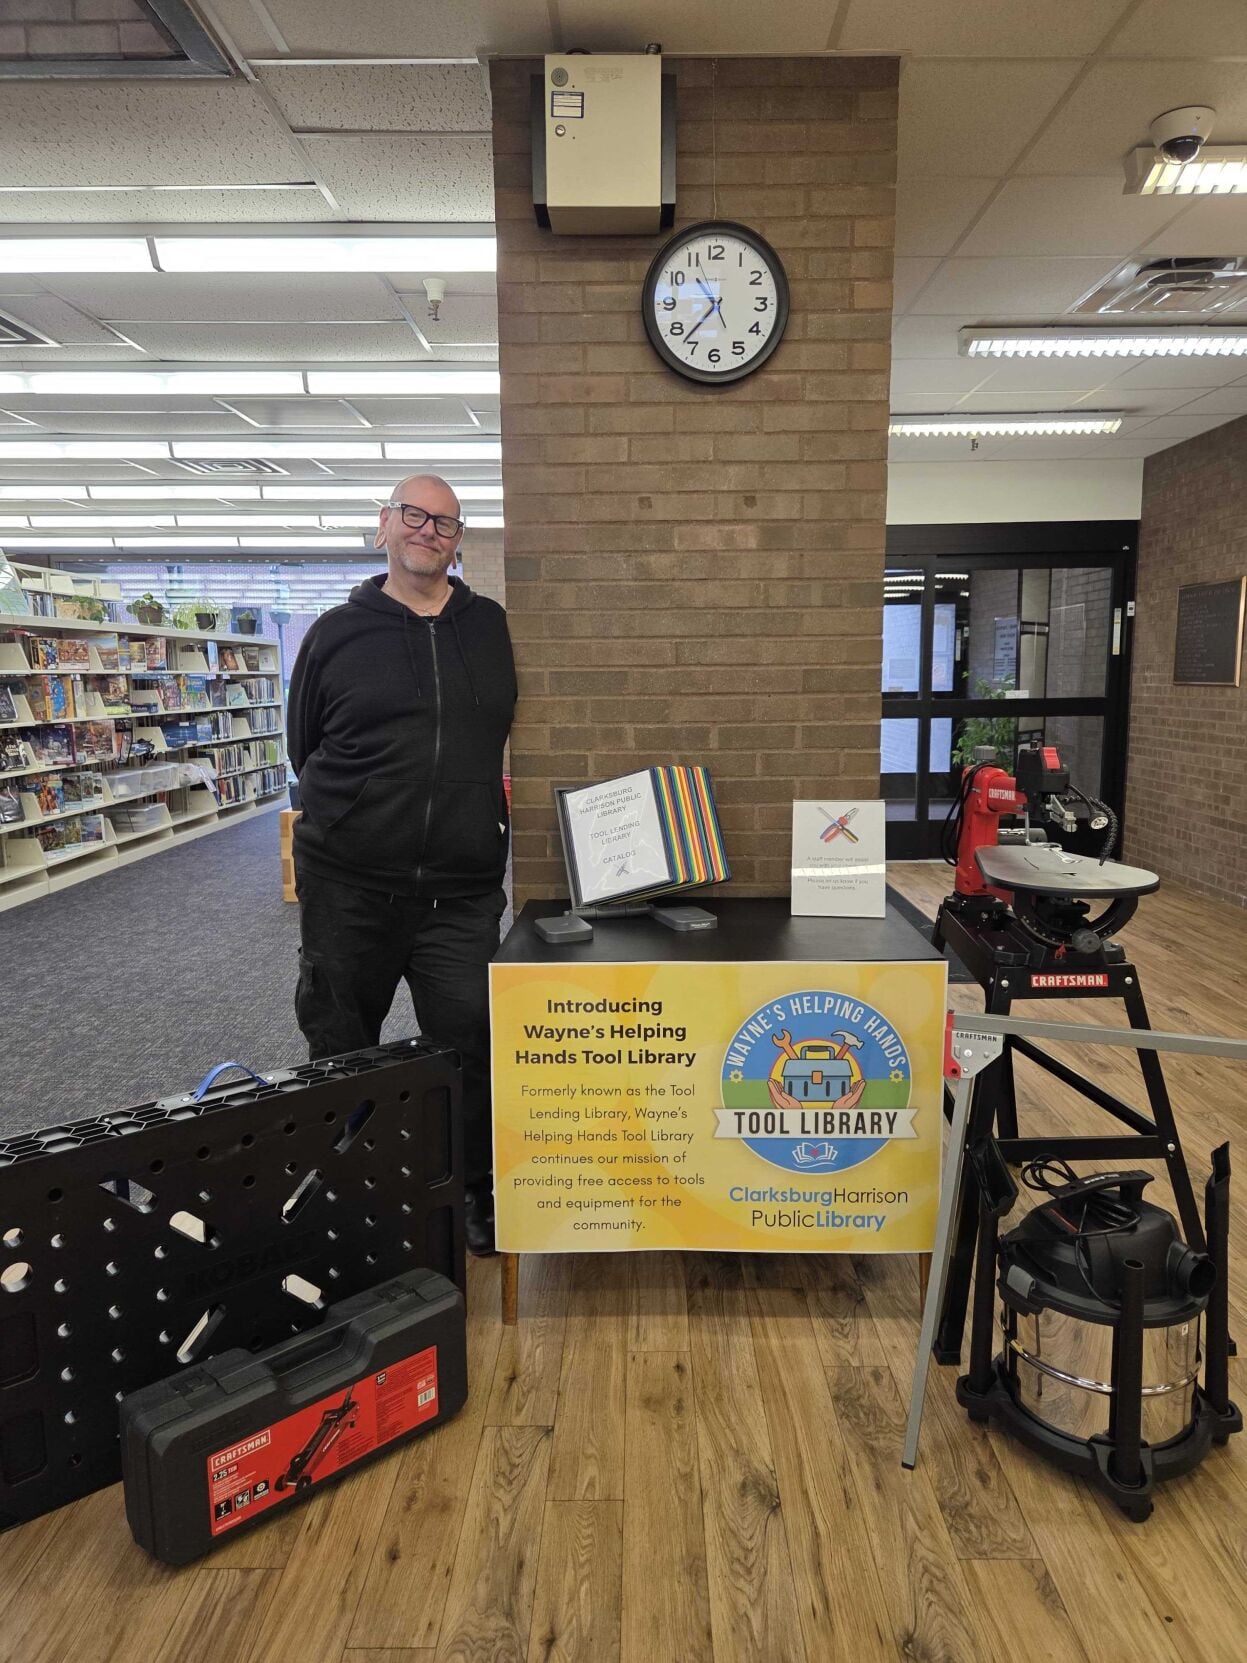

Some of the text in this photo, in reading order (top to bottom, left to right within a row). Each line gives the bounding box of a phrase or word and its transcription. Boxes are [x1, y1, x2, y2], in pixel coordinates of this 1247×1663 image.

[688, 252, 699, 267] 11
[708, 245, 725, 260] 12
[671, 271, 685, 286] 10
[749, 271, 762, 285] 2
[663, 296, 676, 311] 9
[754, 297, 767, 312] 3
[670, 322, 684, 336] 8
[748, 322, 761, 335] 4
[687, 341, 699, 355] 7
[732, 341, 745, 355] 5
[708, 349, 720, 363] 6
[580, 792, 641, 814] HARRISON PUBLIC
[597, 806, 627, 818] LIBRARY
[590, 821, 640, 840] TOOL LENDING
[601, 832, 631, 845] LIBRARY
[603, 850, 636, 864] CATALOG
[1031, 975, 1104, 986] CRAFTSMAN
[547, 998, 663, 1016] Introducing
[523, 1024, 687, 1043] Wayne's Helping
[727, 996, 906, 1067] WAYNE'S HELPING HANDS
[956, 1031, 997, 1042] CRAFTSMAN
[515, 1049, 696, 1068] Hands Tool Library
[521, 1085, 695, 1100] Formerly known as the Tool
[529, 1107, 687, 1124] Lending Library, Wayne's
[734, 1111, 898, 1135] TOOL LIBRARY
[523, 1130, 694, 1146] Helping Hands Tool Library
[531, 1152, 687, 1165] continues our mission of
[513, 1174, 705, 1190] providing free access to tools
[537, 1196, 682, 1212] and equipment for the
[573, 1219, 646, 1232] community.
[215, 1435, 268, 1467] CRAFTSMAN
